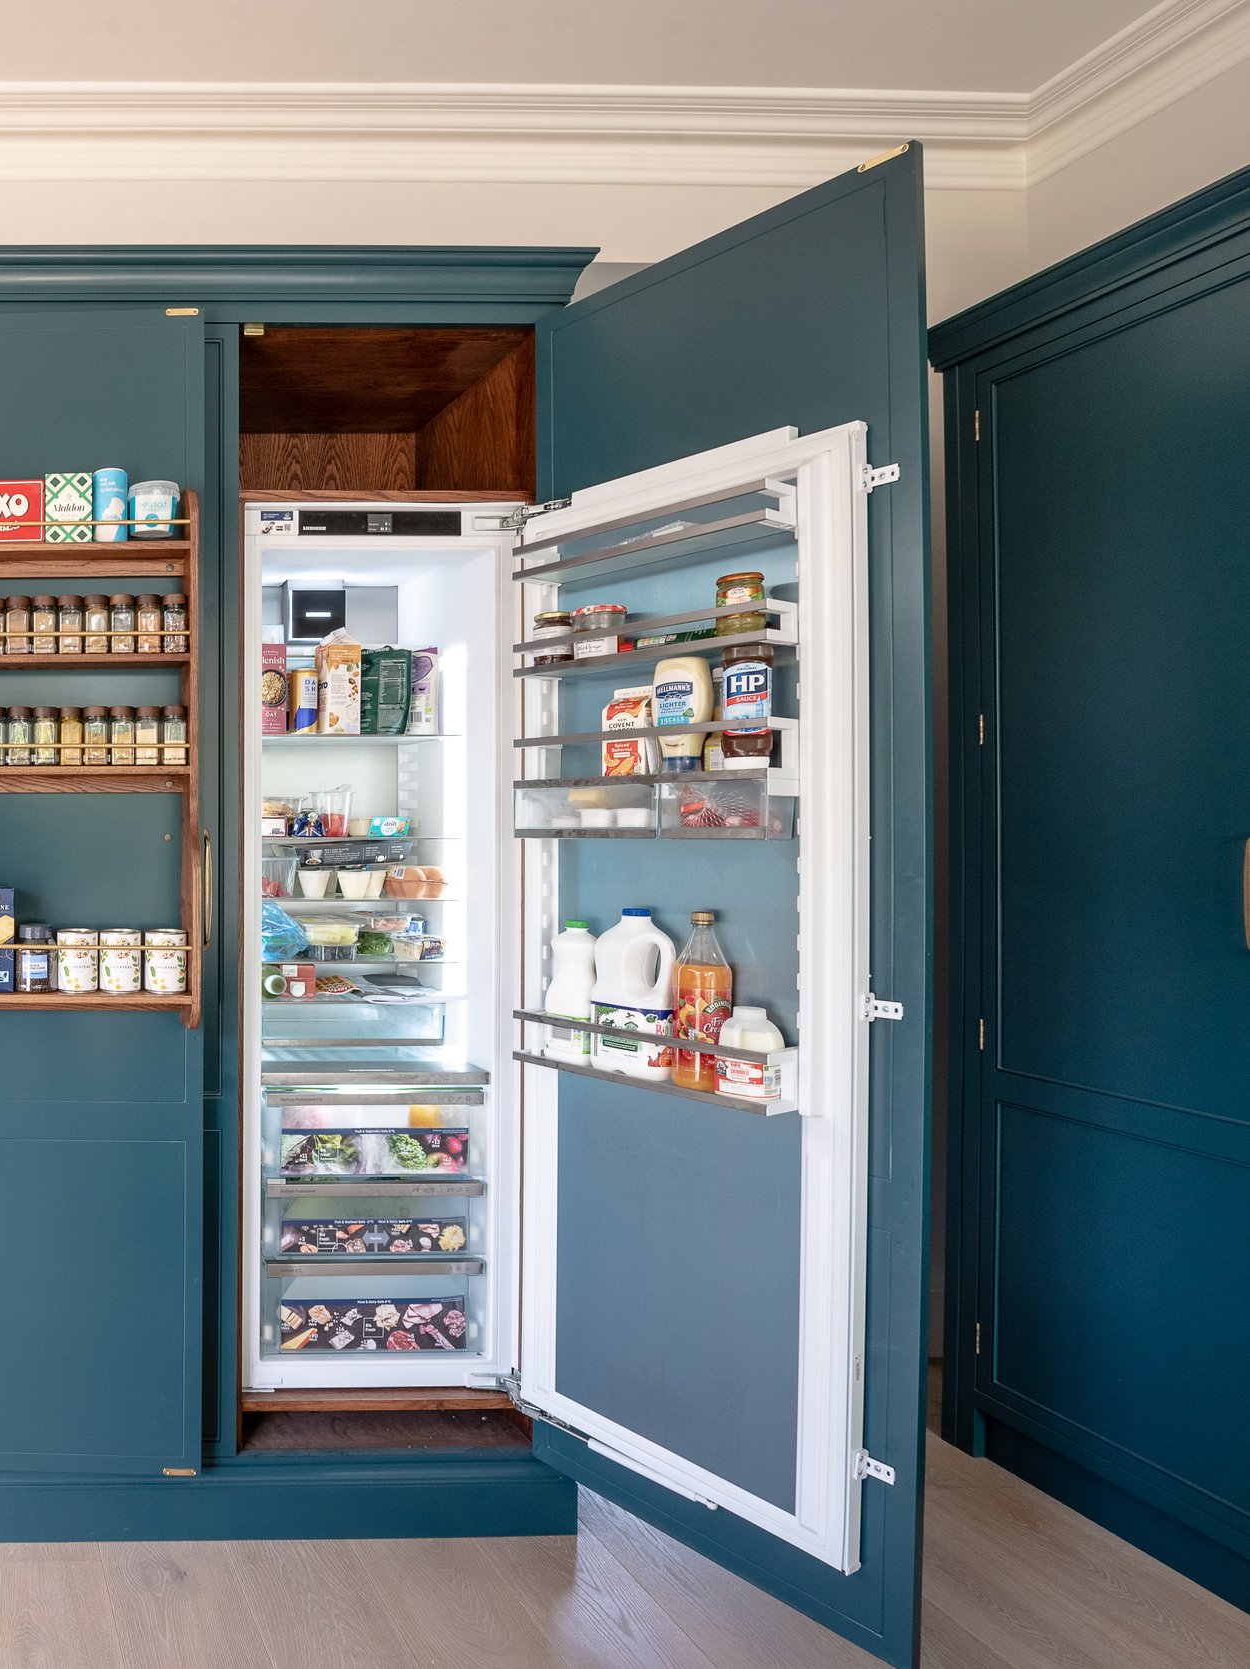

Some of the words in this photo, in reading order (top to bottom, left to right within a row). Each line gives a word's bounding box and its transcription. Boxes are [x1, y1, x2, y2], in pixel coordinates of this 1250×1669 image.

[54, 503, 85, 512] Maldon
[730, 675, 765, 692] HP
[657, 684, 690, 693] HELLMANN'S
[713, 1017, 724, 1026] Fru
